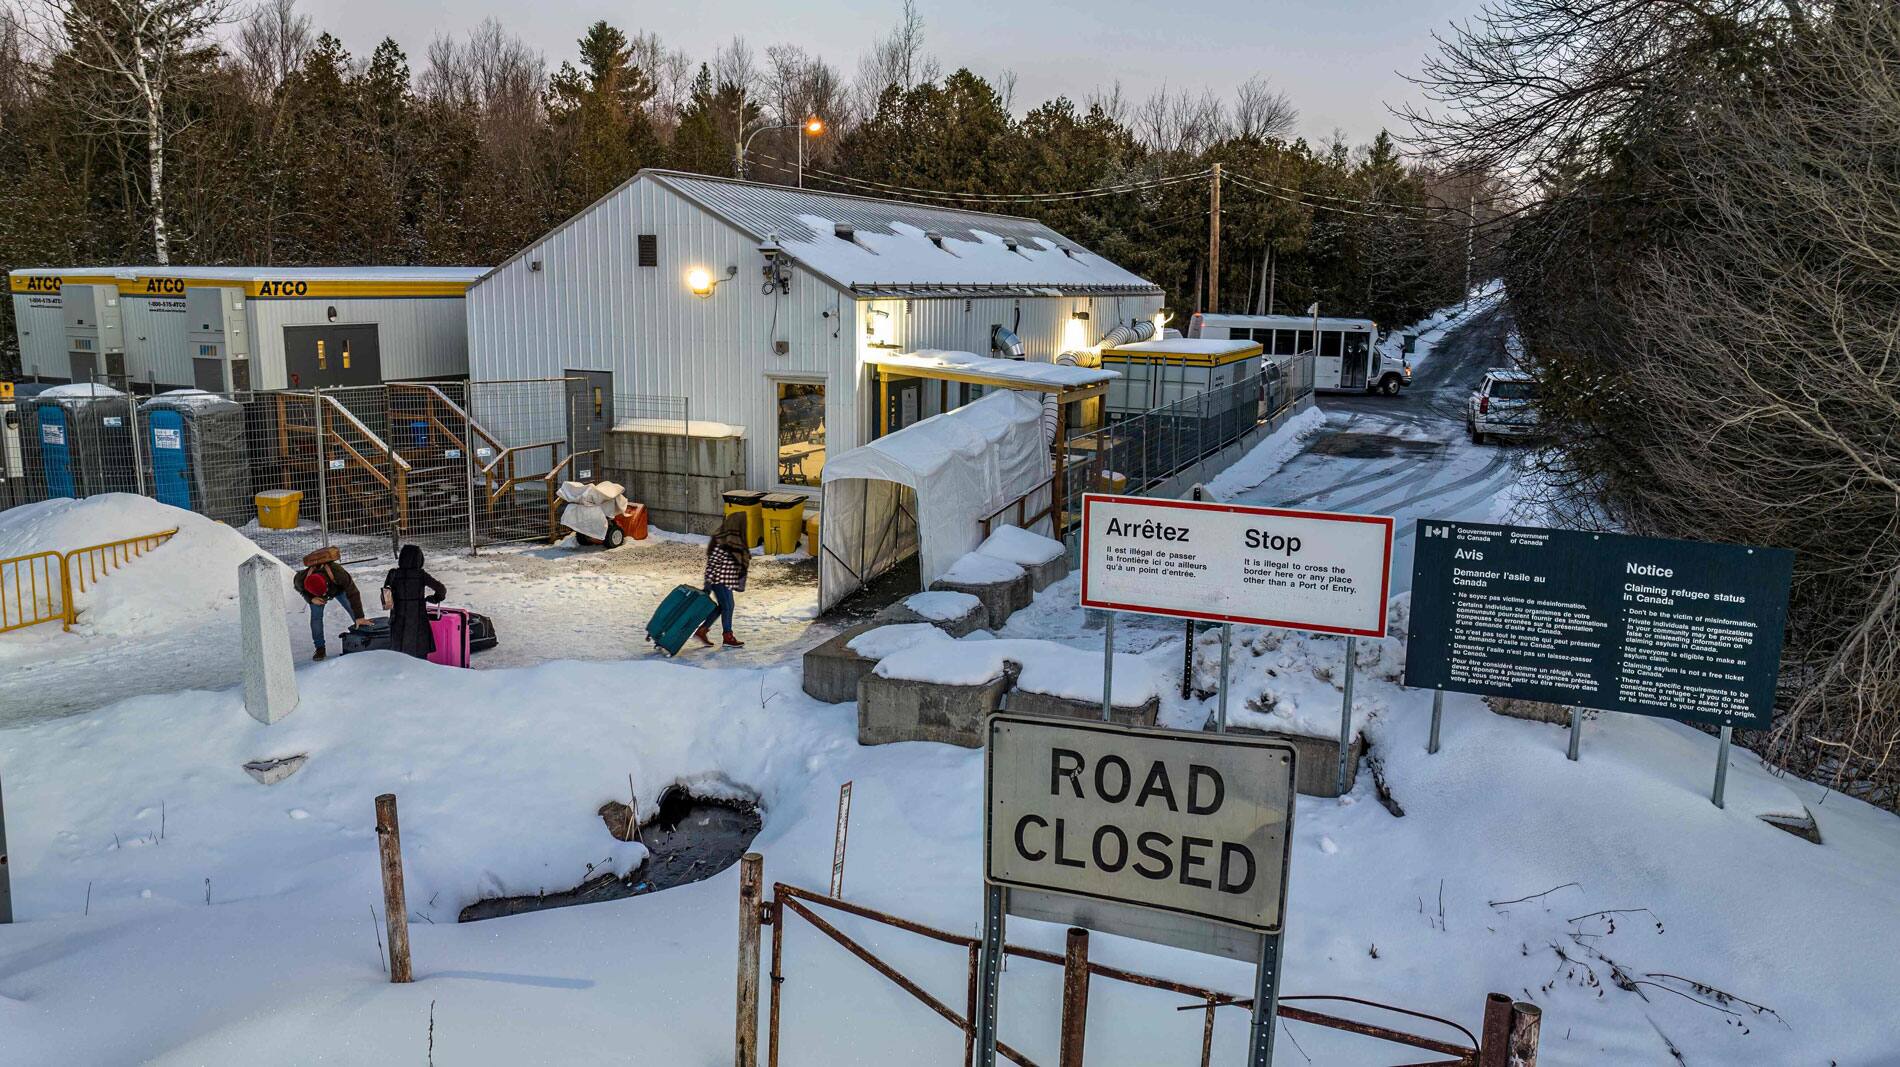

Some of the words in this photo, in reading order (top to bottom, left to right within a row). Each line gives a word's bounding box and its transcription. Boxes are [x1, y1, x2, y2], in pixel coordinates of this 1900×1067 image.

[27, 276, 62, 291] ATCO
[146, 278, 185, 293] ATCO
[259, 280, 307, 296] ATCO
[1106, 518, 1189, 542] Arrêtez
[1457, 528, 1502, 537] Gouvernement
[1510, 532, 1549, 540] Government
[1245, 529, 1301, 557] Stop
[1130, 548, 1153, 558] illégal
[1169, 553, 1196, 561] passer
[1454, 548, 1484, 561] Avis
[1116, 555, 1149, 565] frontière
[1178, 561, 1207, 571] ailleurs
[1264, 560, 1289, 570] illegal
[1332, 566, 1346, 574] the
[1139, 567, 1159, 575] point
[1162, 568, 1196, 578] d'entrée.
[1244, 567, 1272, 576] border
[1275, 570, 1294, 579] here
[1310, 574, 1325, 583] any
[1329, 576, 1352, 584] place
[1454, 568, 1501, 579] Demander
[1504, 572, 1530, 582] l'asile
[1626, 562, 1674, 578] Notice
[1268, 579, 1287, 587] than
[1299, 581, 1317, 590] Port
[1332, 584, 1357, 595] Entry.
[1453, 577, 1487, 587] Canada
[1623, 593, 1633, 601] in
[1636, 594, 1674, 606] Canada
[1624, 583, 1668, 597] Claiming
[1671, 589, 1710, 600] refugee
[1714, 593, 1745, 604] status
[1537, 600, 1587, 610] mésinformation.
[1525, 609, 1562, 617] organismes
[1554, 624, 1594, 632] présentation
[1568, 618, 1608, 628] informations
[1628, 618, 1651, 626] Private
[1653, 620, 1689, 630] individuals
[1706, 628, 1753, 637] organizations
[1704, 617, 1758, 628] misinformation.
[1537, 627, 1563, 636] Canada.
[1530, 642, 1556, 650] Canada.
[1626, 637, 1654, 646] claiming
[1690, 644, 1718, 653] Canada.
[1692, 638, 1732, 648] information
[1720, 635, 1753, 645] providing
[1454, 642, 1485, 651] Demander
[1463, 650, 1488, 658] Canada.
[1638, 648, 1669, 657] everyone
[1680, 653, 1705, 661] eligible
[1623, 661, 1652, 672] Claiming
[1451, 669, 1470, 677] Sinon,
[1537, 674, 1569, 682] exigences
[1550, 669, 1574, 677] réfugié,
[1637, 669, 1664, 678] Canada.
[1484, 680, 1513, 688] d'origine.
[1621, 676, 1640, 684] There
[1683, 686, 1728, 696] requirements
[1620, 684, 1657, 693] considered
[1666, 690, 1691, 698] refugee
[1696, 706, 1723, 715] country
[1050, 748, 1224, 815] ROAD
[1014, 814, 1256, 894] CLOSED
